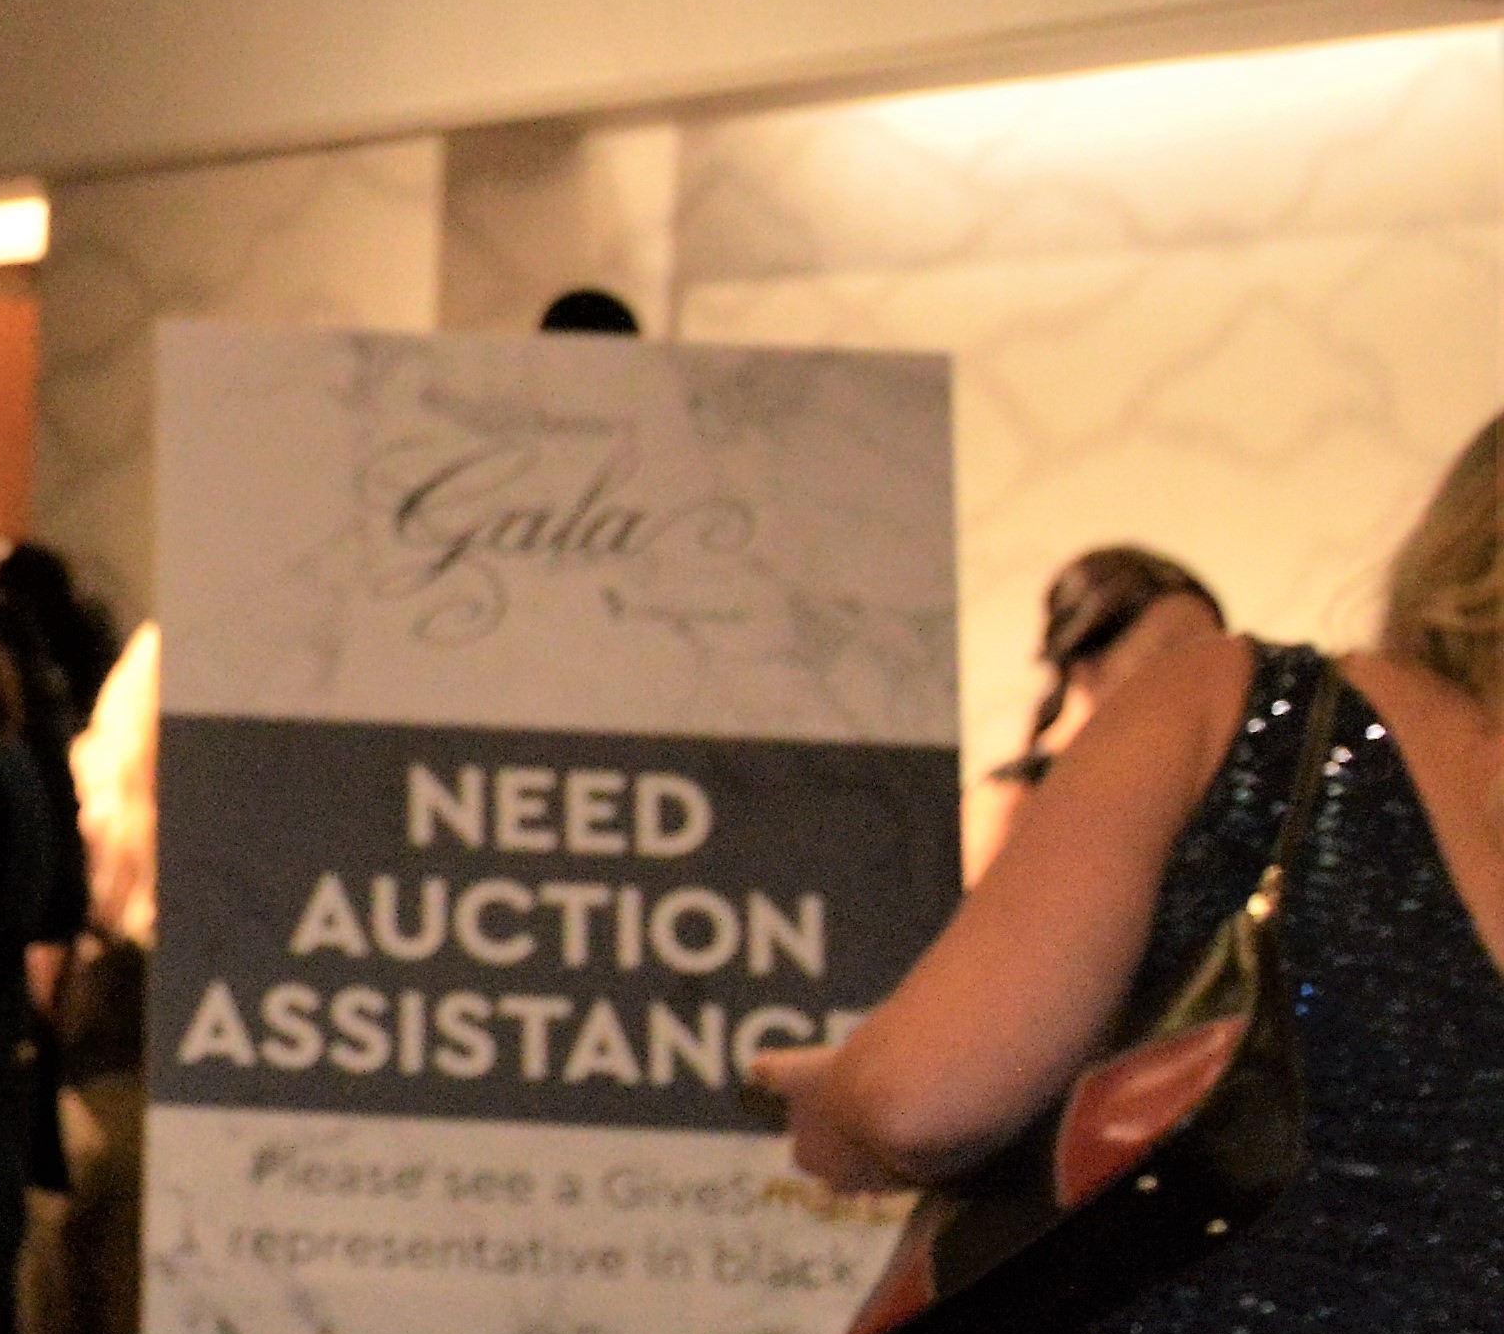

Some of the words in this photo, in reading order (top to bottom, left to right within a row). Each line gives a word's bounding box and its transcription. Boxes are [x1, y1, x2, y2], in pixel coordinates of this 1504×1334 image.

[356, 425, 756, 649] Gala
[404, 763, 716, 859] NEED
[289, 873, 828, 979] AUCTION
[177, 980, 876, 1091] ASSISTANC
[252, 1143, 424, 1200] Please
[442, 1168, 536, 1204] see
[555, 1173, 584, 1207] a
[229, 1225, 629, 1279] representative
[644, 1232, 691, 1281] in
